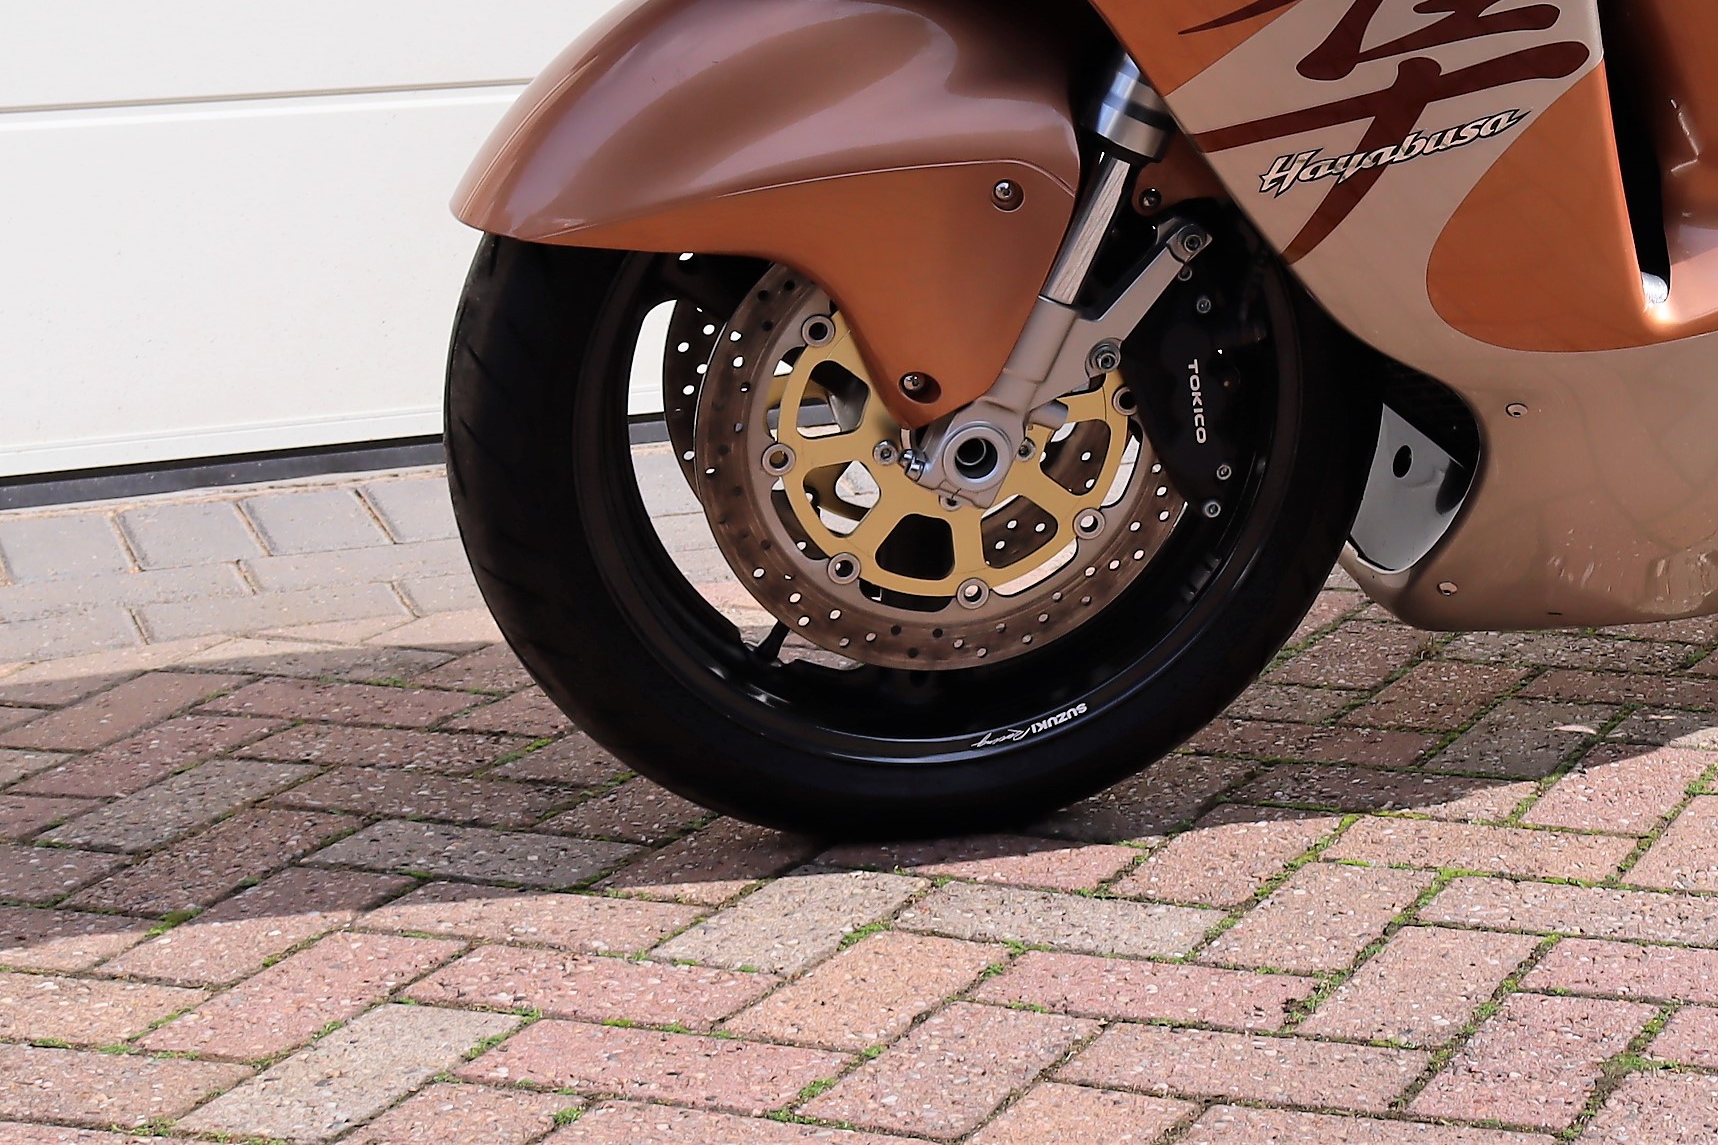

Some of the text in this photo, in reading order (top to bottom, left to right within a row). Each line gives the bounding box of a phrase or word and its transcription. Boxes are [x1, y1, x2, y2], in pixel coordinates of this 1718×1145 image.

[1259, 108, 1531, 198] Hayabusa
[1188, 359, 1207, 444] TOKICO
[1030, 702, 1088, 734] SUZUKI
